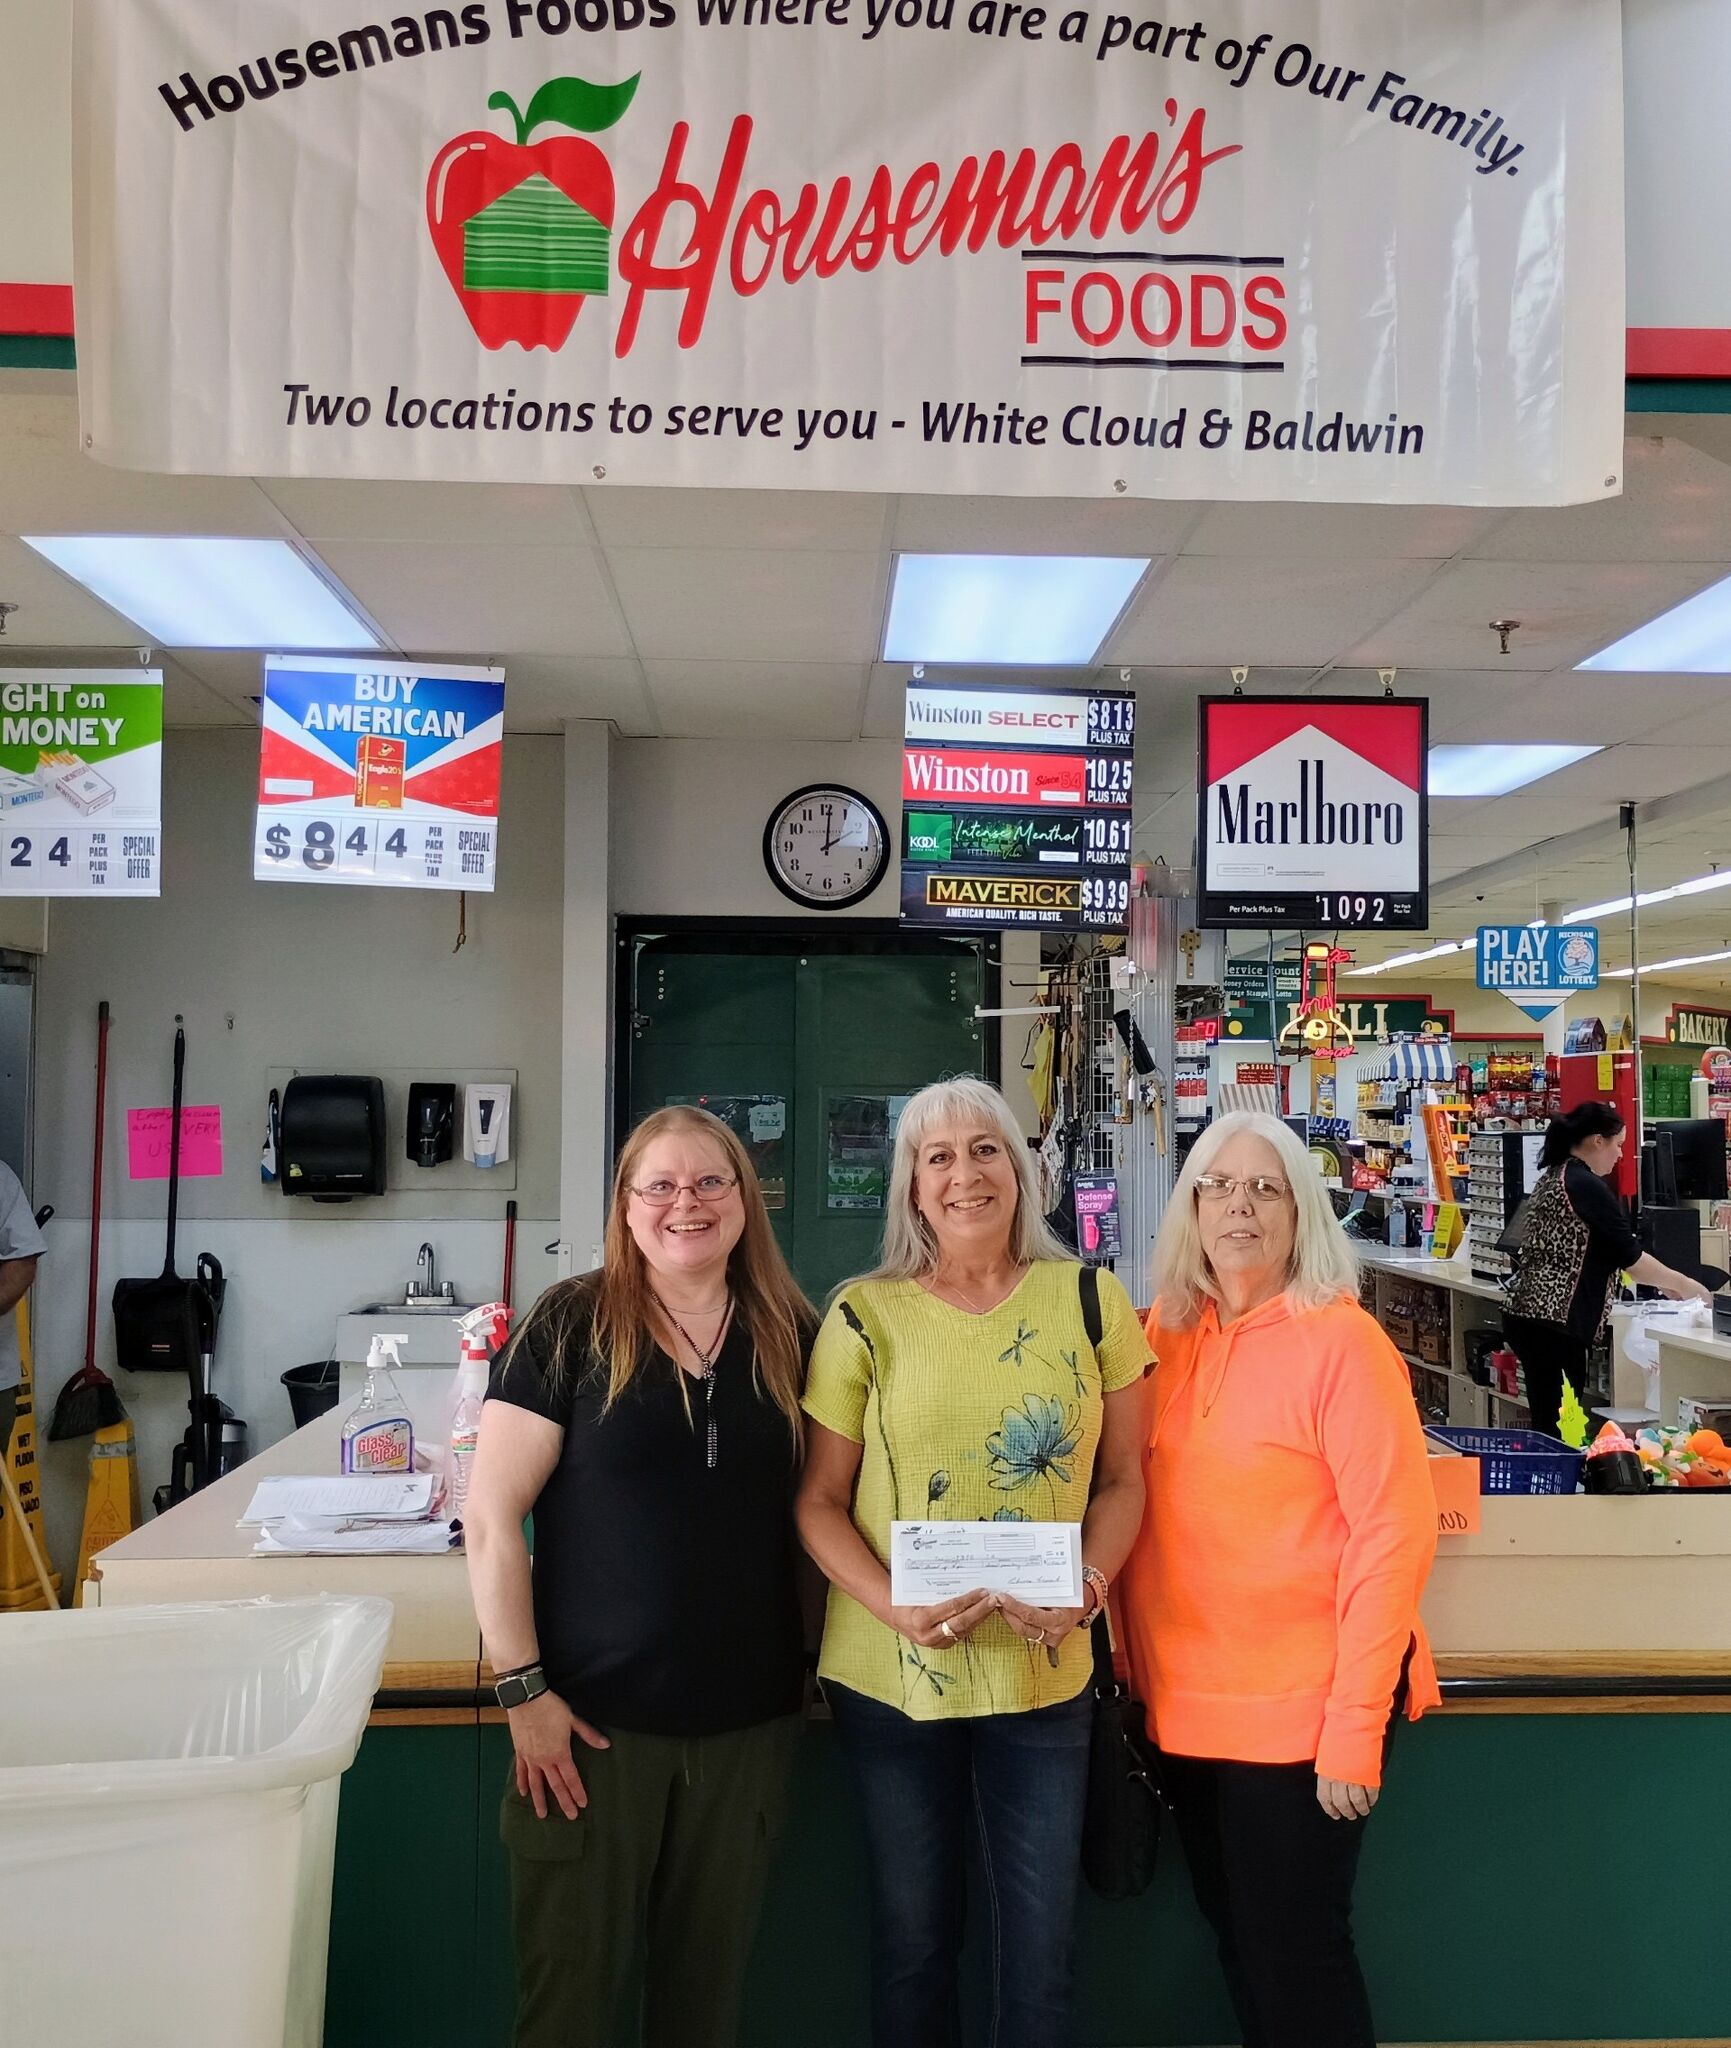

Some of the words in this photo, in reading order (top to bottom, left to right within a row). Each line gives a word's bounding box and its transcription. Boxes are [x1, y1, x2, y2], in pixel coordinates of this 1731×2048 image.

[159, 5, 491, 132] Housemans
[862, 0, 954, 40] you
[968, 0, 1047, 41] are
[1058, 14, 1084, 43] a
[1097, 8, 1204, 62] part
[1214, 33, 1272, 88] of
[1274, 43, 1365, 102] Our
[1367, 70, 1529, 177] Family.
[614, 98, 1243, 359] Houseman's
[1025, 270, 1288, 351] FOODS
[283, 384, 372, 428] Two
[384, 386, 596, 435] locations
[608, 396, 653, 435] to
[664, 405, 785, 439] serve
[792, 406, 877, 451] you
[921, 402, 1048, 446] White
[1063, 405, 1187, 450] Cloud
[1200, 413, 1233, 450] &
[1244, 409, 1425, 456] Baldwin
[355, 674, 419, 704] BUY
[76, 692, 105, 709] on
[909, 700, 982, 725] Winston
[988, 711, 1079, 728] SELECT
[1088, 699, 1134, 731] $8.13
[302, 703, 465, 739] AMERICAN
[2, 717, 124, 746] MONEY
[1091, 732, 1113, 743] PLUS
[1114, 733, 1130, 745] TAX
[906, 754, 1029, 795] Winston
[1088, 791, 1109, 802] PLUS
[1111, 792, 1128, 803] TAX
[1216, 759, 1403, 845] Marlboro
[802, 809, 813, 821] 11
[820, 804, 833, 816] 12
[428, 826, 442, 837] PER
[789, 823, 803, 835] 10
[955, 820, 1011, 843] Intense
[1014, 821, 1079, 846] Menthol
[92, 833, 106, 844] PER
[425, 839, 443, 851] PACK
[458, 830, 490, 852] SPECIAL
[910, 836, 939, 848] KOOL
[89, 847, 108, 857] PACK
[123, 836, 156, 857] SPECIAL
[784, 841, 794, 852] 9
[461, 853, 484, 874] OFFER
[1086, 852, 1108, 863] PLUS
[1110, 852, 1126, 864] TAX
[89, 861, 107, 871] PLUS
[127, 859, 150, 879] OFFER
[426, 866, 439, 877] TAX
[790, 859, 800, 871] 8
[92, 874, 105, 885] TAX
[805, 873, 813, 885] 7
[823, 878, 832, 890] 6
[843, 873, 851, 885] 5
[936, 881, 1073, 905] MAVERICK
[1082, 879, 1128, 909] $9.39
[946, 907, 984, 918] AMERICAN
[985, 908, 1017, 920] QUALITY.
[1019, 909, 1037, 920] RICH
[1039, 910, 1063, 922] TASTE.
[1229, 905, 1240, 913] Per
[1241, 905, 1257, 914] Pack
[1259, 905, 1272, 914] Plus
[1273, 905, 1285, 914] Tax
[1084, 912, 1106, 923] PLUS
[1107, 912, 1124, 924] TAX
[1558, 931, 1594, 939] MICHIGAN
[1484, 930, 1549, 960] PLAY
[1227, 964, 1263, 975] ervice
[1272, 966, 1312, 978] ountr
[1484, 961, 1548, 986] HERE!
[1243, 980, 1264, 988] Orders
[1559, 975, 1594, 984] LOTTERY
[1679, 1012, 1728, 1046] BAKERY
[181, 1122, 219, 1135] VERY
[1078, 1193, 1113, 1202] Defense
[1078, 1201, 1103, 1211] Spray
[358, 1433, 392, 1453] Glass
[1438, 1510, 1468, 1531] ND
